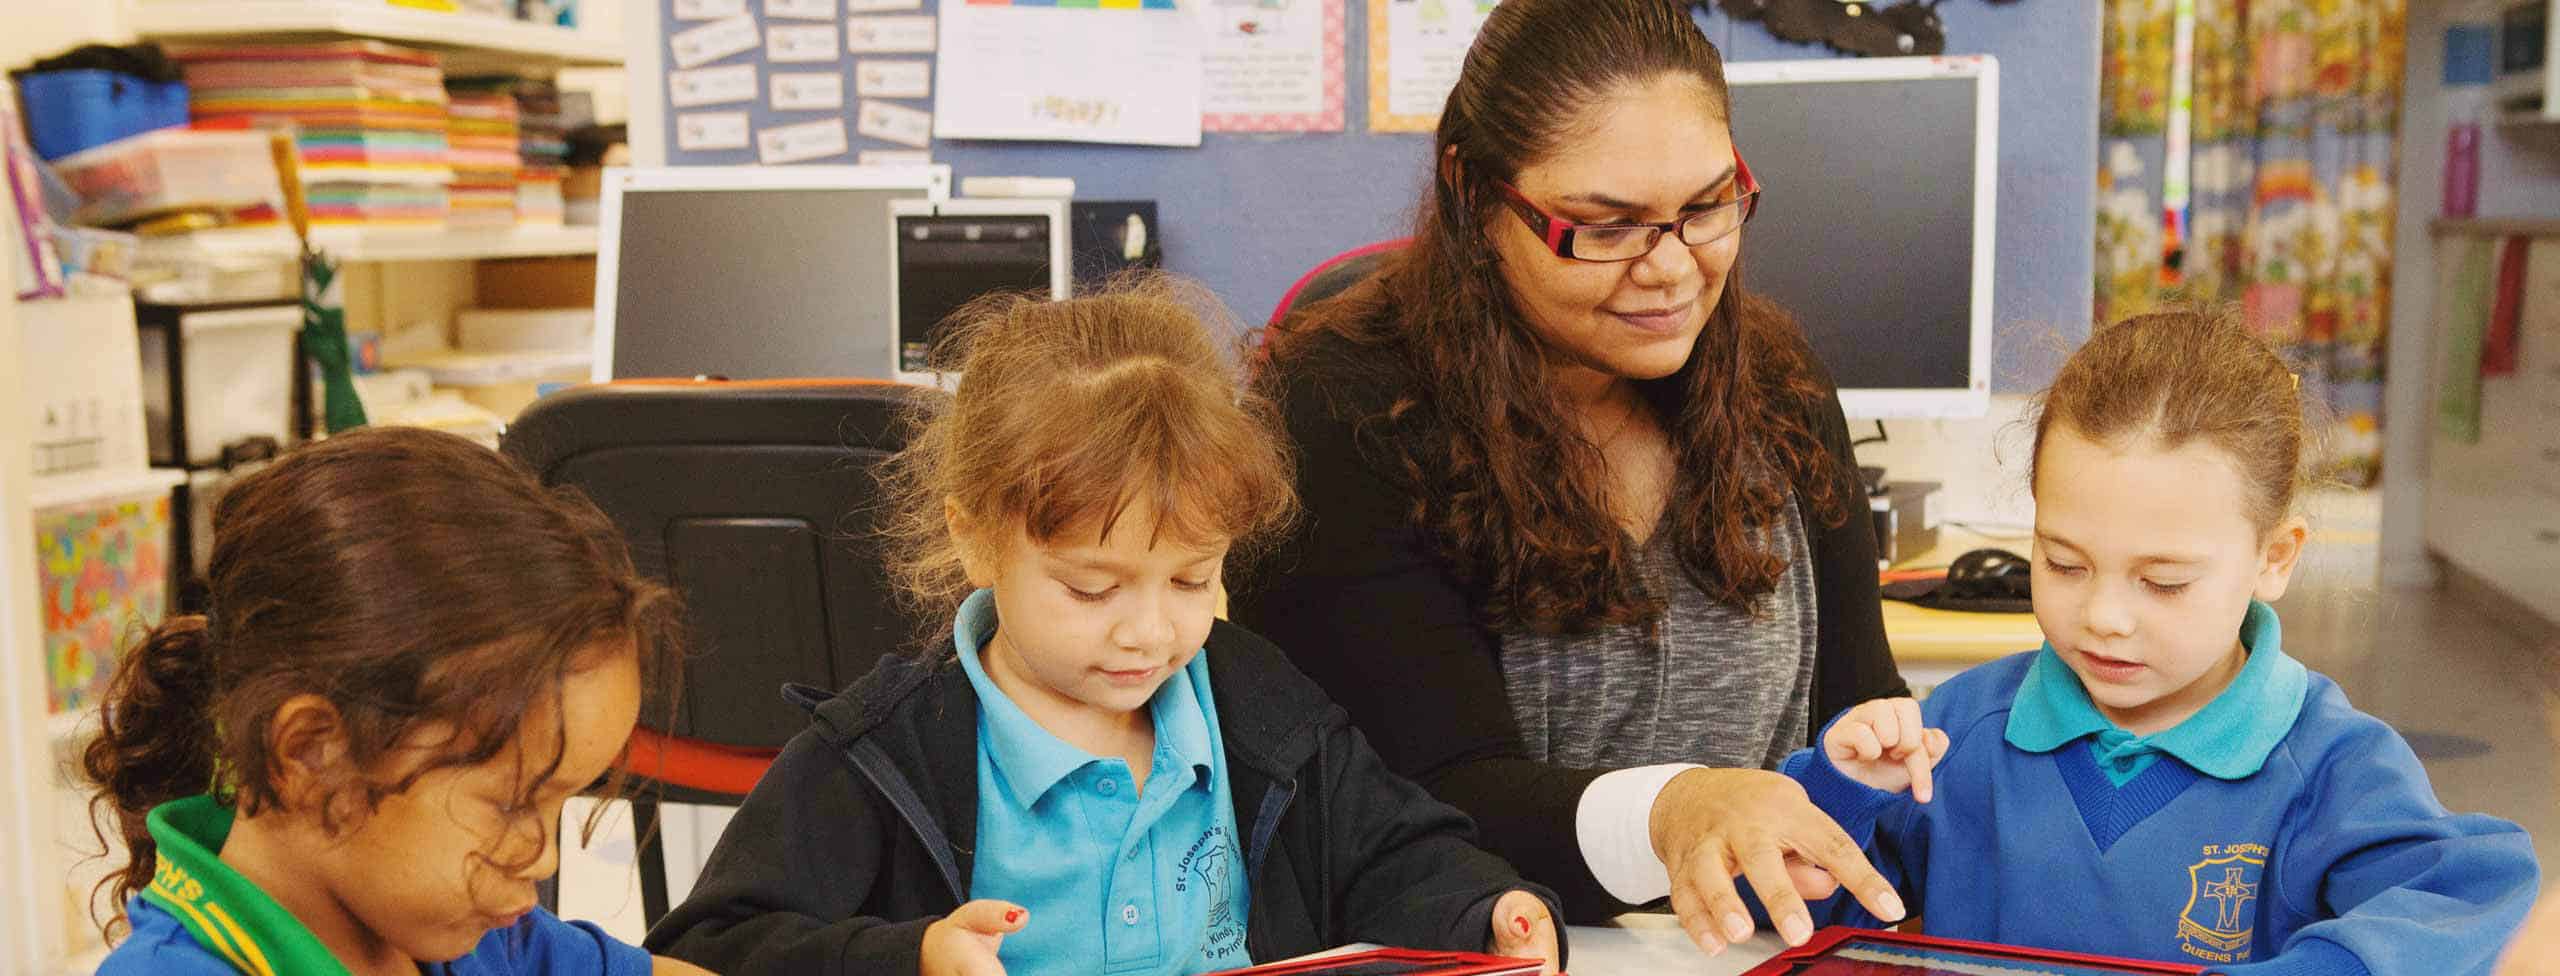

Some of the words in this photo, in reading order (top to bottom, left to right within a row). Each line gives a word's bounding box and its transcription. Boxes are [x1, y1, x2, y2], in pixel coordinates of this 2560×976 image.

[1178, 826, 1222, 873] Joseph's
[2203, 845, 2220, 856] ST.
[1175, 877, 1187, 892] St
[1209, 925, 1235, 945] Kindy
[2182, 942, 2232, 963] QUEENS
